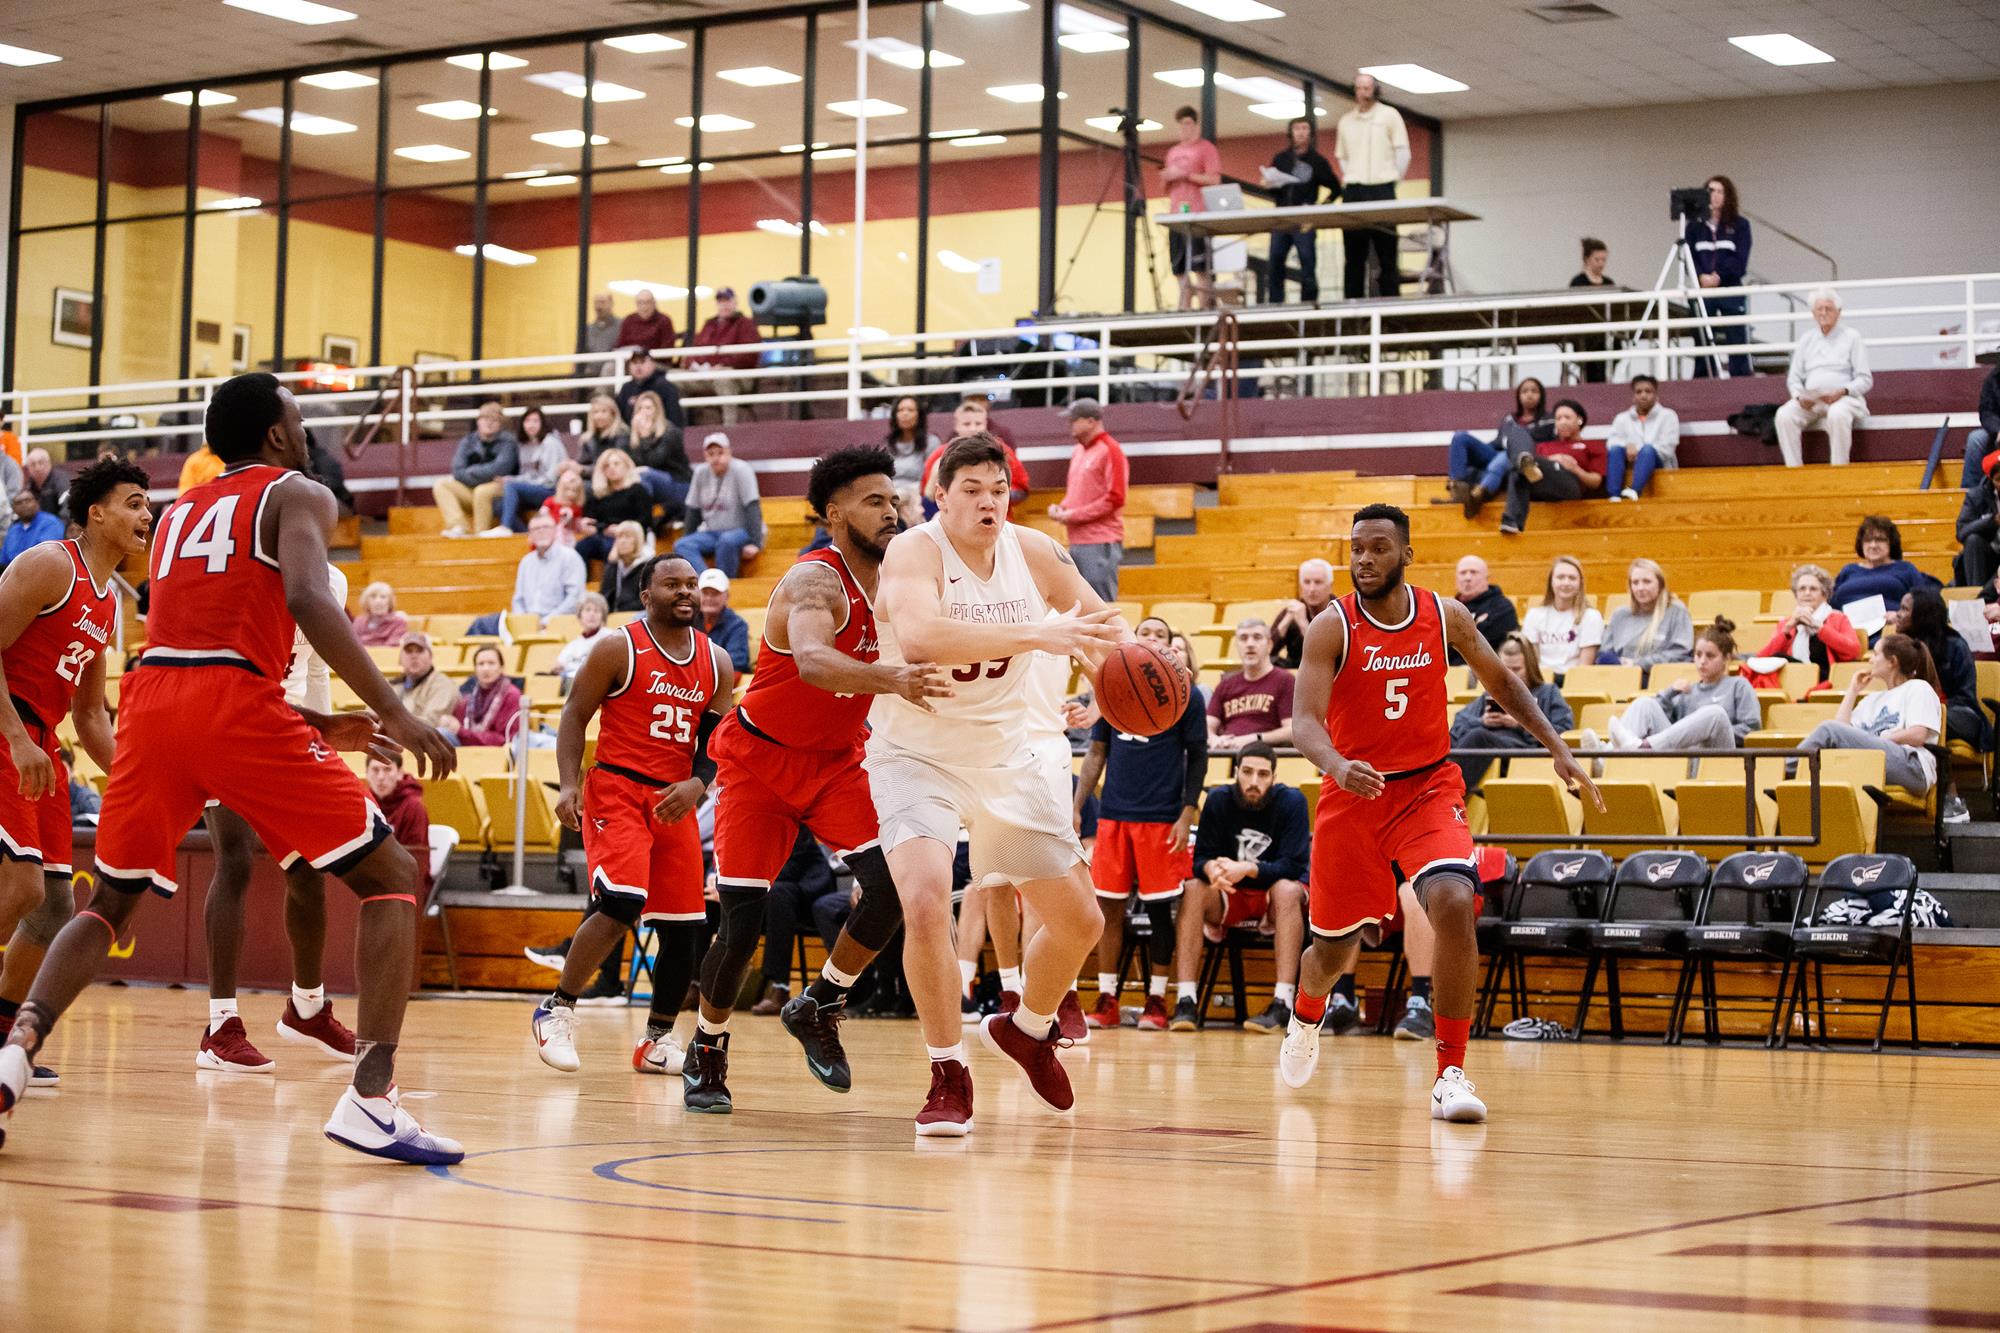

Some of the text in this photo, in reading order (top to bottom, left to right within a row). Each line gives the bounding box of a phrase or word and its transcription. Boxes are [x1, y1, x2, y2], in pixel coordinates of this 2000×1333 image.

[157, 494, 241, 581] 14
[72, 603, 109, 645] Tornado
[1361, 642, 1433, 672] Tornado
[646, 670, 705, 703] Tornado
[1138, 661, 1170, 708] NCAA
[1384, 677, 1409, 720] 5
[1223, 693, 1275, 718] ERSKINE
[649, 703, 693, 743] 25
[1510, 926, 1546, 936] ERSKINE
[1604, 927, 1641, 938] ERSKINE
[1703, 930, 1741, 940] ERSKINE
[1810, 932, 1849, 942] ERSKINE
